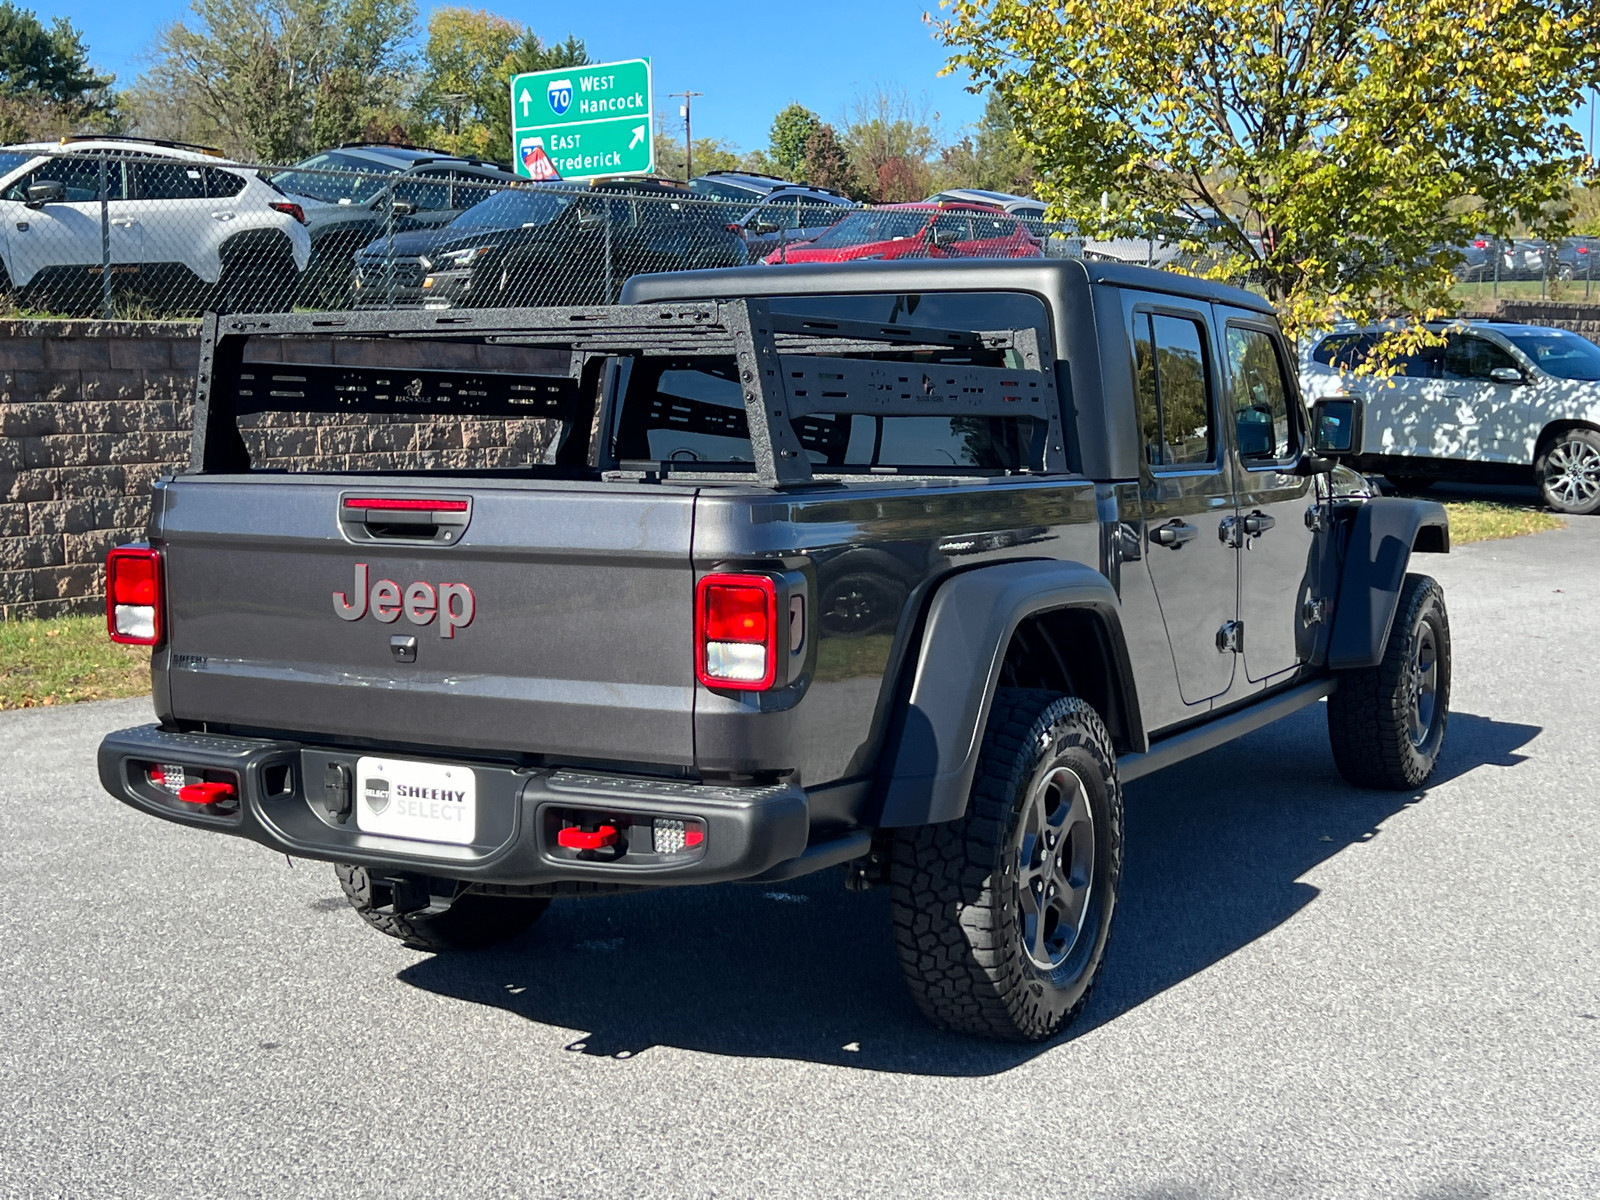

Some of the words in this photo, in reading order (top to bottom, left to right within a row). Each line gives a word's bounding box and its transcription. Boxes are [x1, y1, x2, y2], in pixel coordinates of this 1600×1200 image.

[579, 75, 615, 92] WEST
[551, 90, 569, 108] 70
[579, 92, 643, 114] Hancock
[551, 134, 581, 150] EAST
[551, 151, 621, 170] Frederick
[332, 563, 475, 639] Jeep
[364, 788, 390, 798] SELECT
[396, 784, 465, 802] SHEEHY
[396, 799, 466, 821] SELECT
